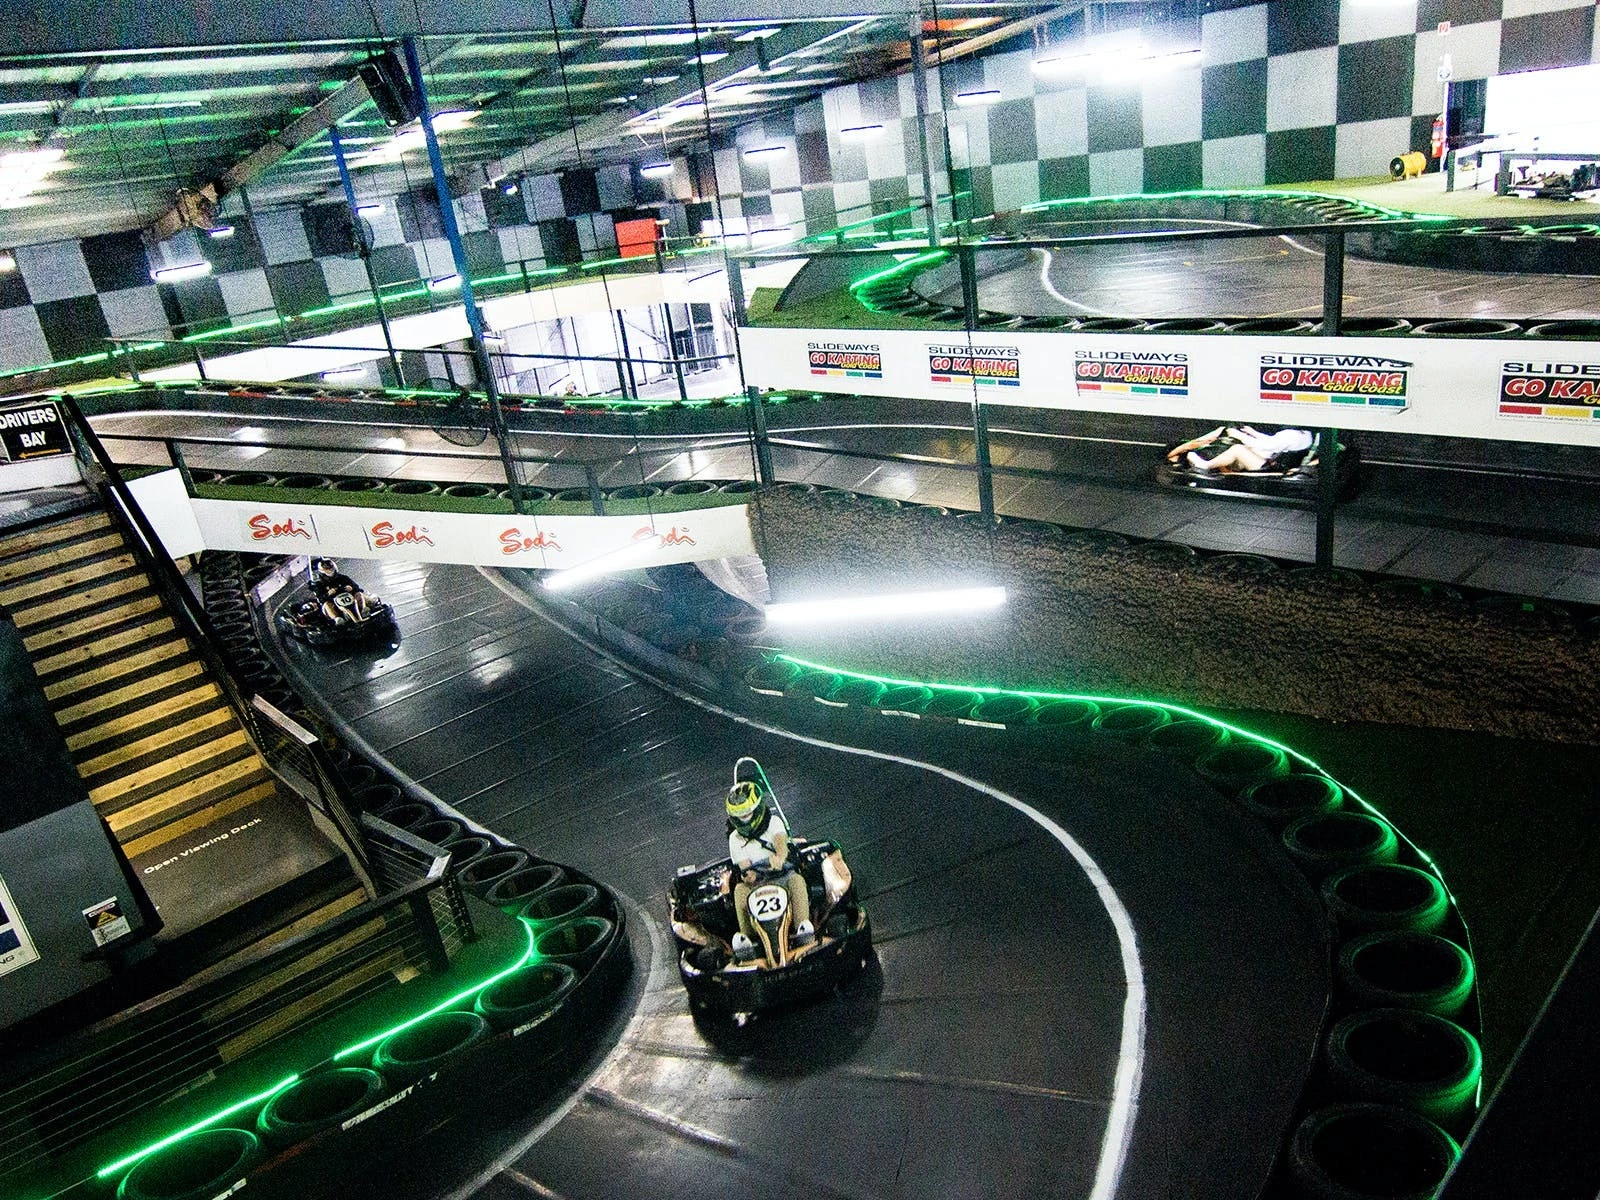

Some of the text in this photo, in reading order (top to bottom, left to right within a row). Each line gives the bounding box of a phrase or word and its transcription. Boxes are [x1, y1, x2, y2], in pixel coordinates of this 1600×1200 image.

[807, 342, 880, 351] SLIDEWAYS
[928, 346, 1019, 357] SLIDEWAYS
[810, 352, 880, 367] GO KARTING
[1074, 350, 1188, 363] SLIDEWAYS
[1260, 355, 1413, 368] SLIDEWAYS
[931, 357, 1018, 373] GO KARTING
[990, 369, 1018, 377] Coast
[1078, 362, 1186, 380] GO KARTING
[1503, 362, 1600, 376] SLIDE
[1123, 374, 1186, 385] Gold Coast
[1262, 368, 1404, 388] GO KARTING
[1322, 381, 1404, 395] Gold Coast
[1504, 377, 1600, 400] GO KA
[0, 407, 57, 429] DRIVERS
[20, 430, 46, 447] BAY
[248, 513, 312, 540] Sodi
[370, 521, 434, 548] Sodi
[499, 527, 562, 554] Sodi
[143, 817, 262, 874] Open Viewing Deck
[756, 897, 782, 916] 23
